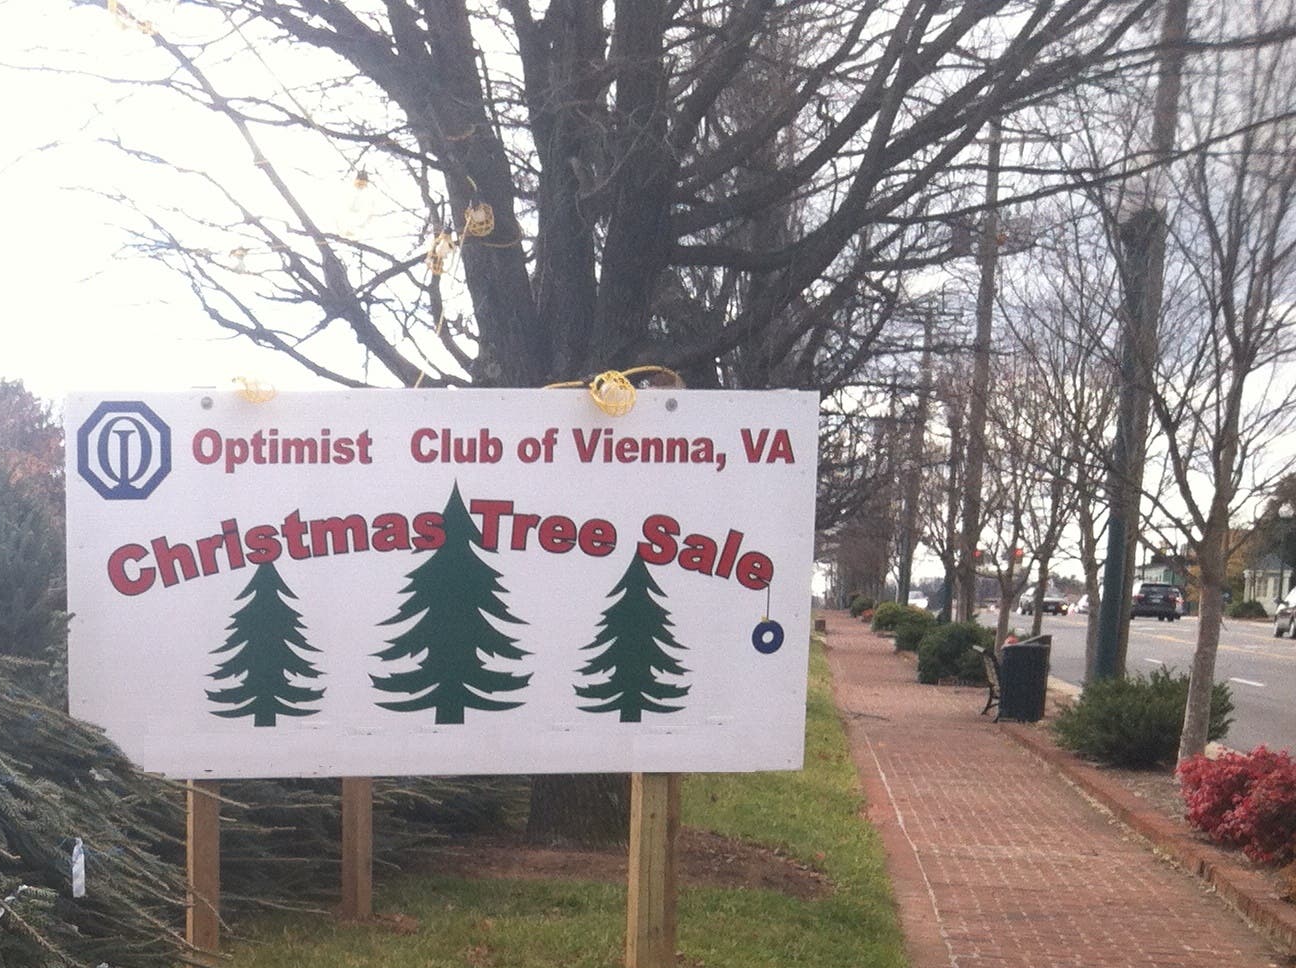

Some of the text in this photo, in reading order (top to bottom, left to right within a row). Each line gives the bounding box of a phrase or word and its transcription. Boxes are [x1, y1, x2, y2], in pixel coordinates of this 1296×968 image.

[192, 427, 796, 474] Optimist Club of Vienna, VA
[107, 498, 775, 597] Christmas Tree Sale
